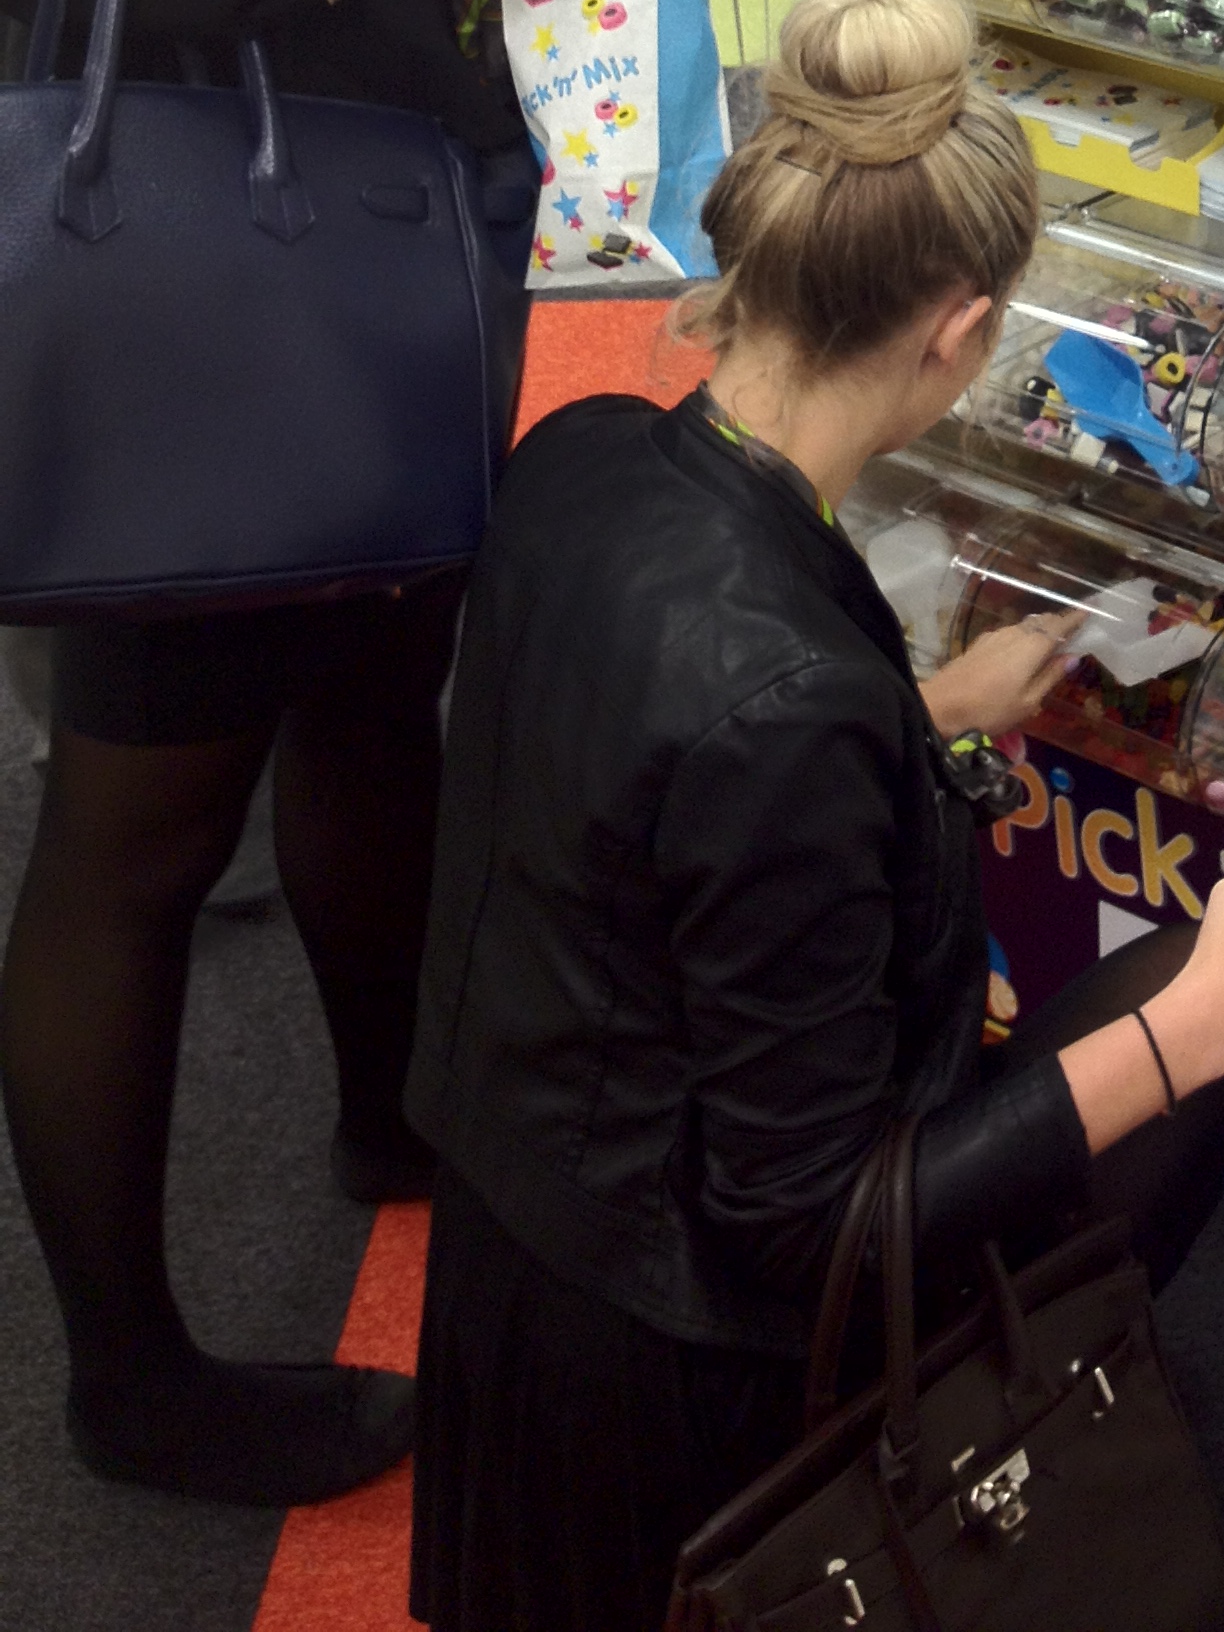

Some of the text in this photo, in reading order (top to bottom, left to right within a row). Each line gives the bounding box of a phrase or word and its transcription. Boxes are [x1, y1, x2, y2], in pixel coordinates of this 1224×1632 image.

[521, 83, 553, 119] ick
[581, 55, 640, 89] Mix
[992, 761, 1205, 919] Pick
